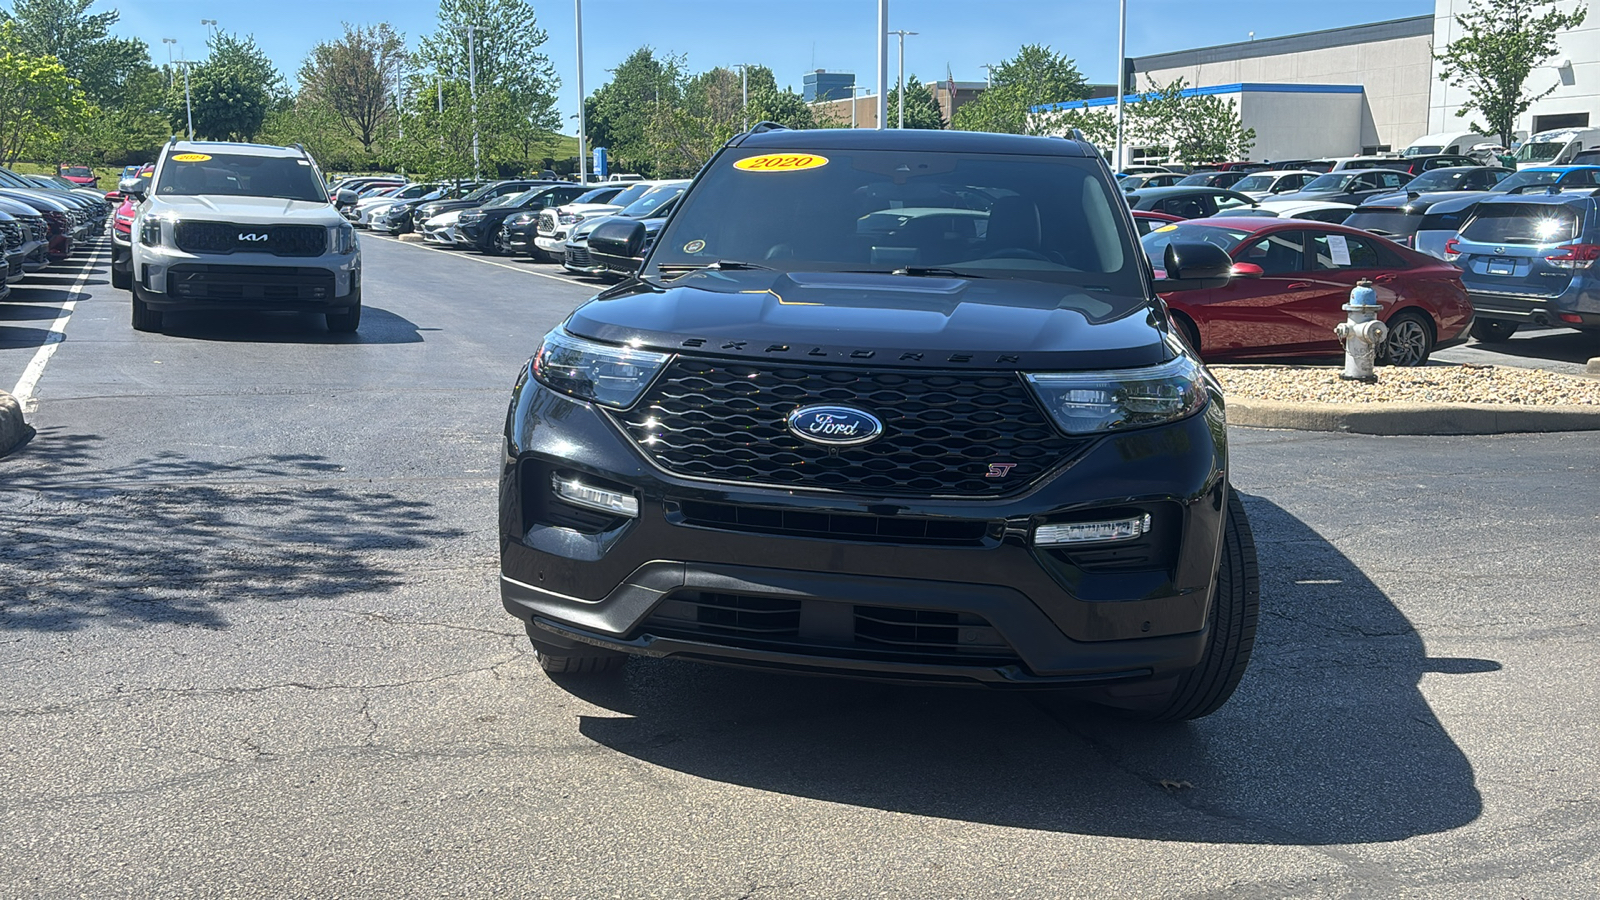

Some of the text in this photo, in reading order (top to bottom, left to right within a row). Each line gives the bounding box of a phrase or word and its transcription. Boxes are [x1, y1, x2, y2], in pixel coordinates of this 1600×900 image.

[748, 156, 813, 169] 2020
[238, 233, 268, 241] KIA
[681, 337, 1020, 364] EXPLORER
[809, 413, 859, 435] Ford
[985, 462, 1017, 478] ST
